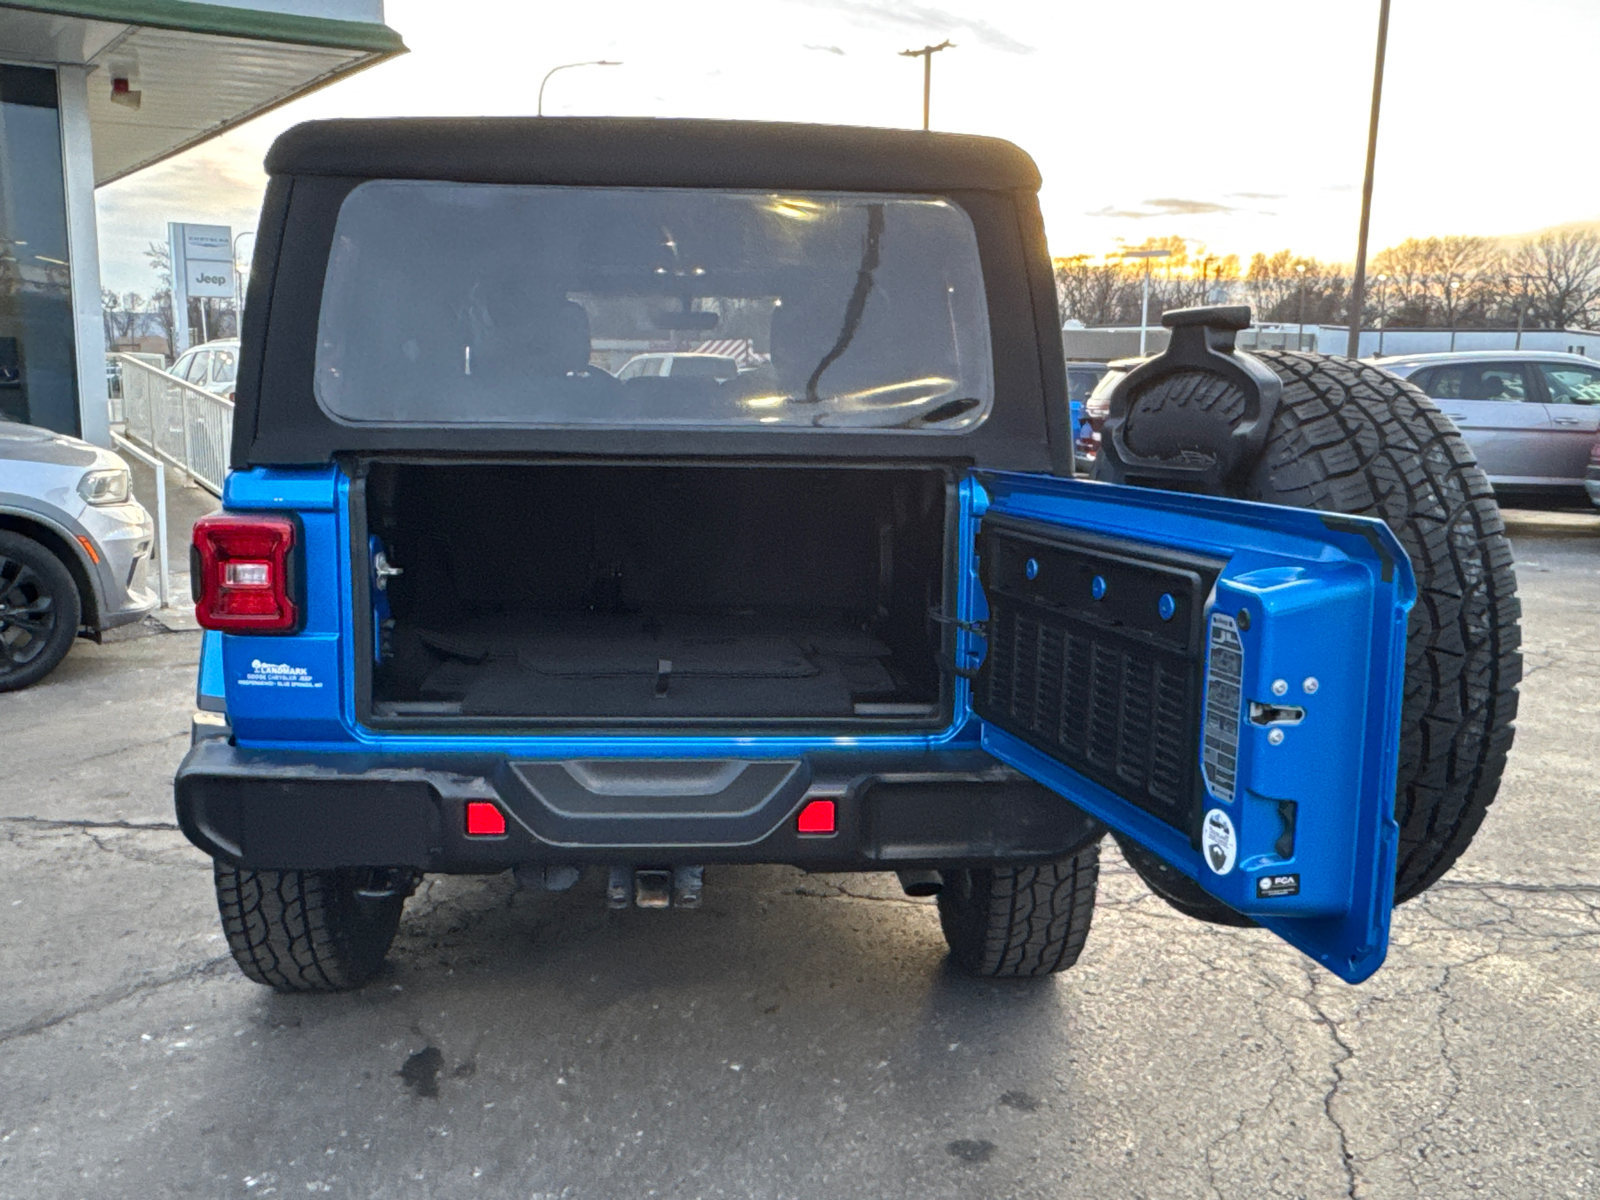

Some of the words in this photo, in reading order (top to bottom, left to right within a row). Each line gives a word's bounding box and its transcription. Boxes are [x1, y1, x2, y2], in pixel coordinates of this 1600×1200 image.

[195, 273, 226, 286] Jeep
[260, 667, 307, 675] LANDMARK
[1275, 876, 1295, 884] FCA
